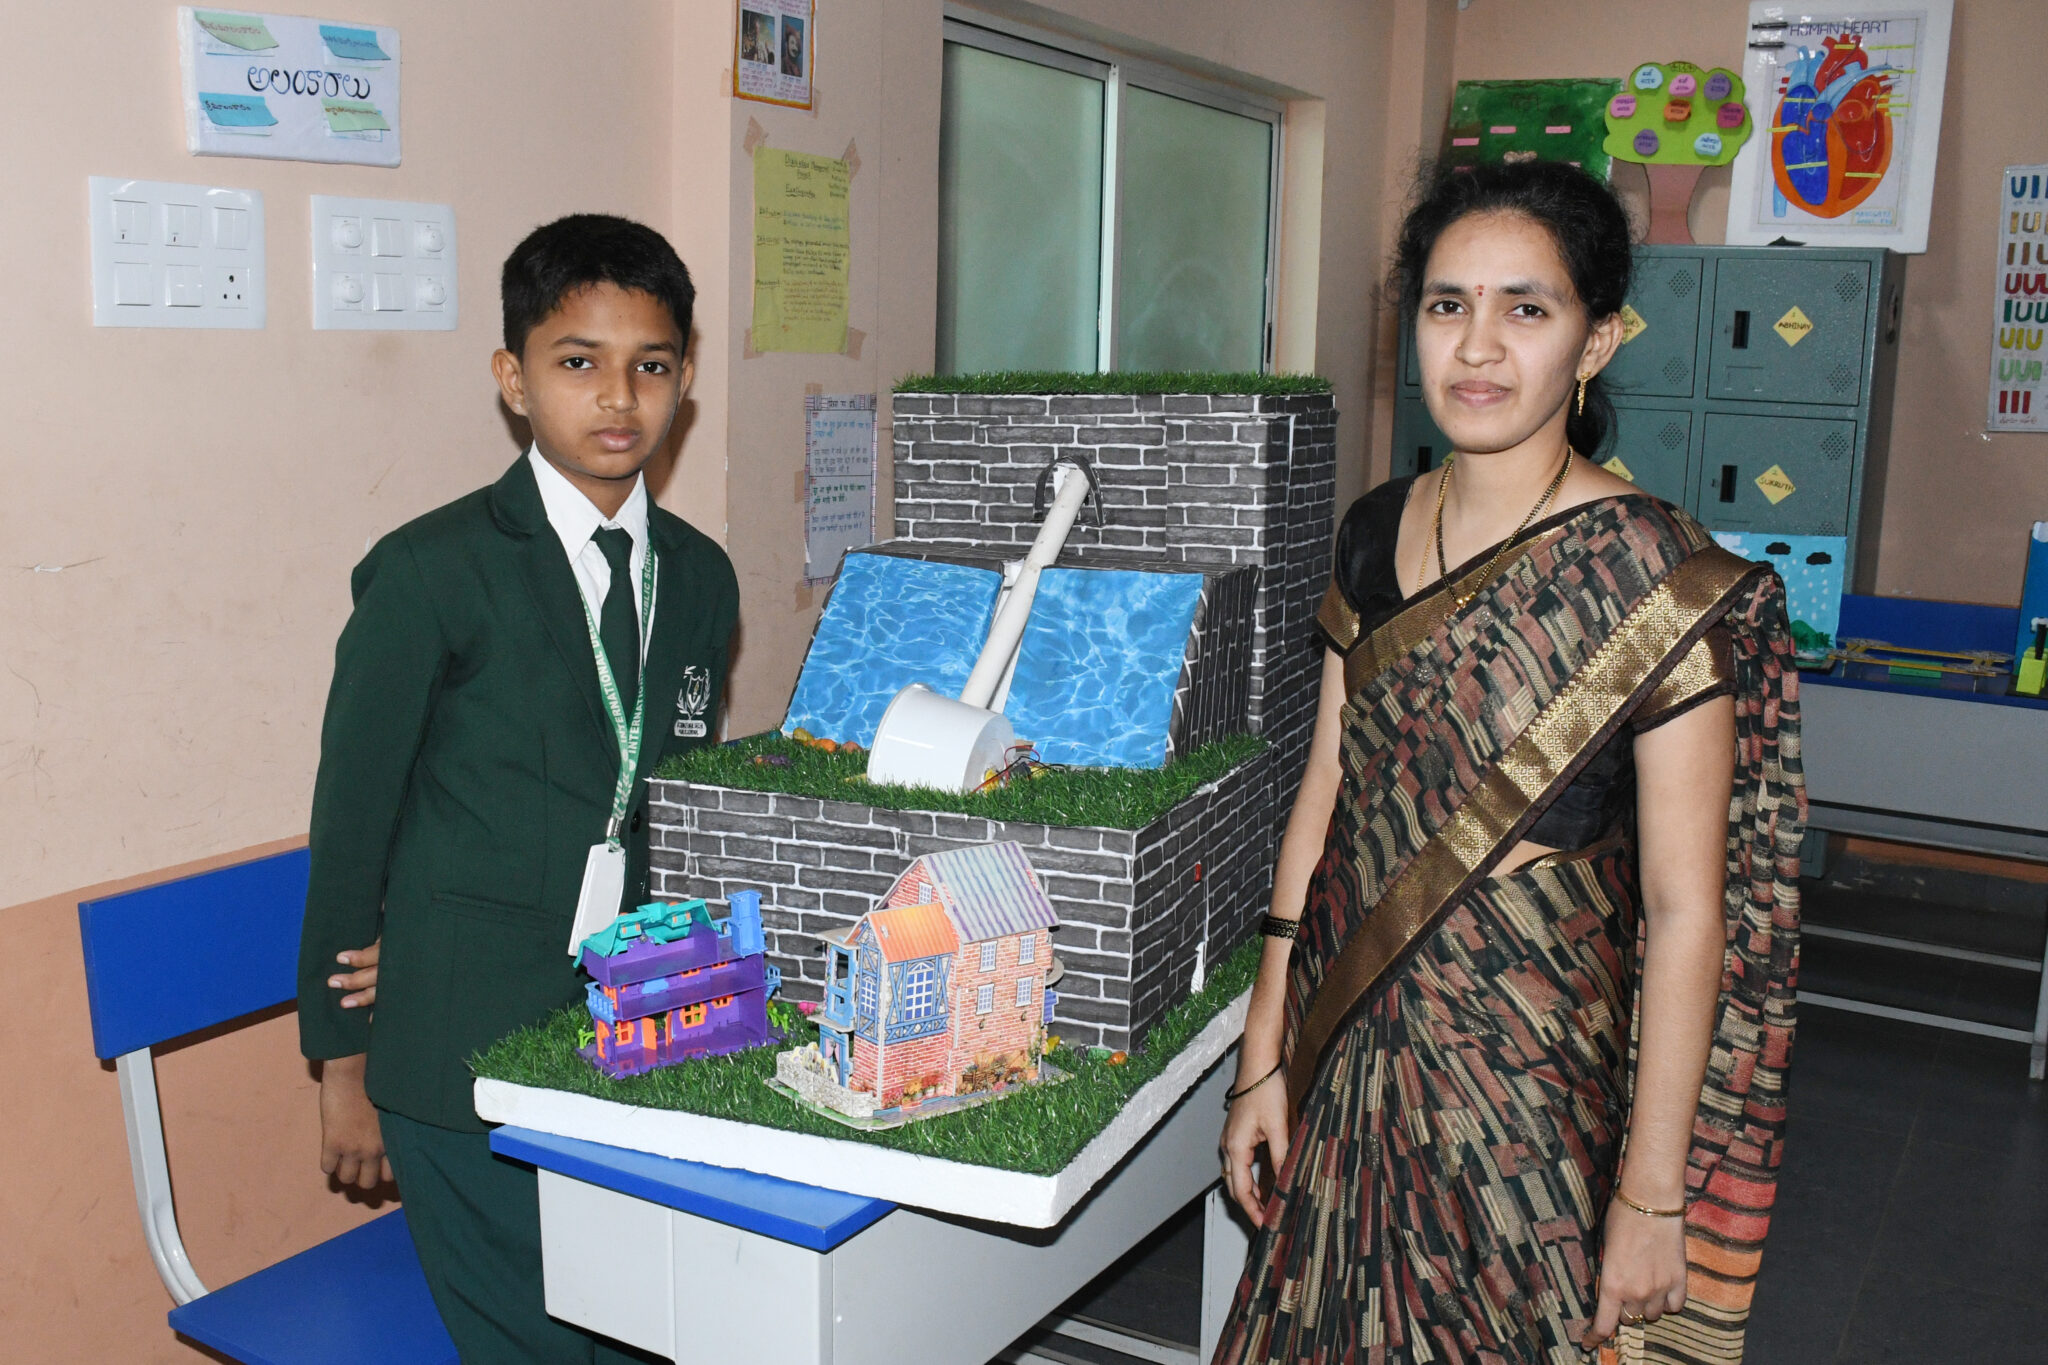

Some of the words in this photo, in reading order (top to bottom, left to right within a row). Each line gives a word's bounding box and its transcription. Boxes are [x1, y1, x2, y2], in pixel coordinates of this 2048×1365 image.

[1789, 24, 1840, 37] HUMAN
[1843, 20, 1891, 35] HEART
[247, 66, 371, 100] అలంకారాలు
[644, 543, 653, 580] SCHOO
[594, 651, 629, 744] INTERNATIONAL
[627, 671, 645, 755] INTERNATIO
